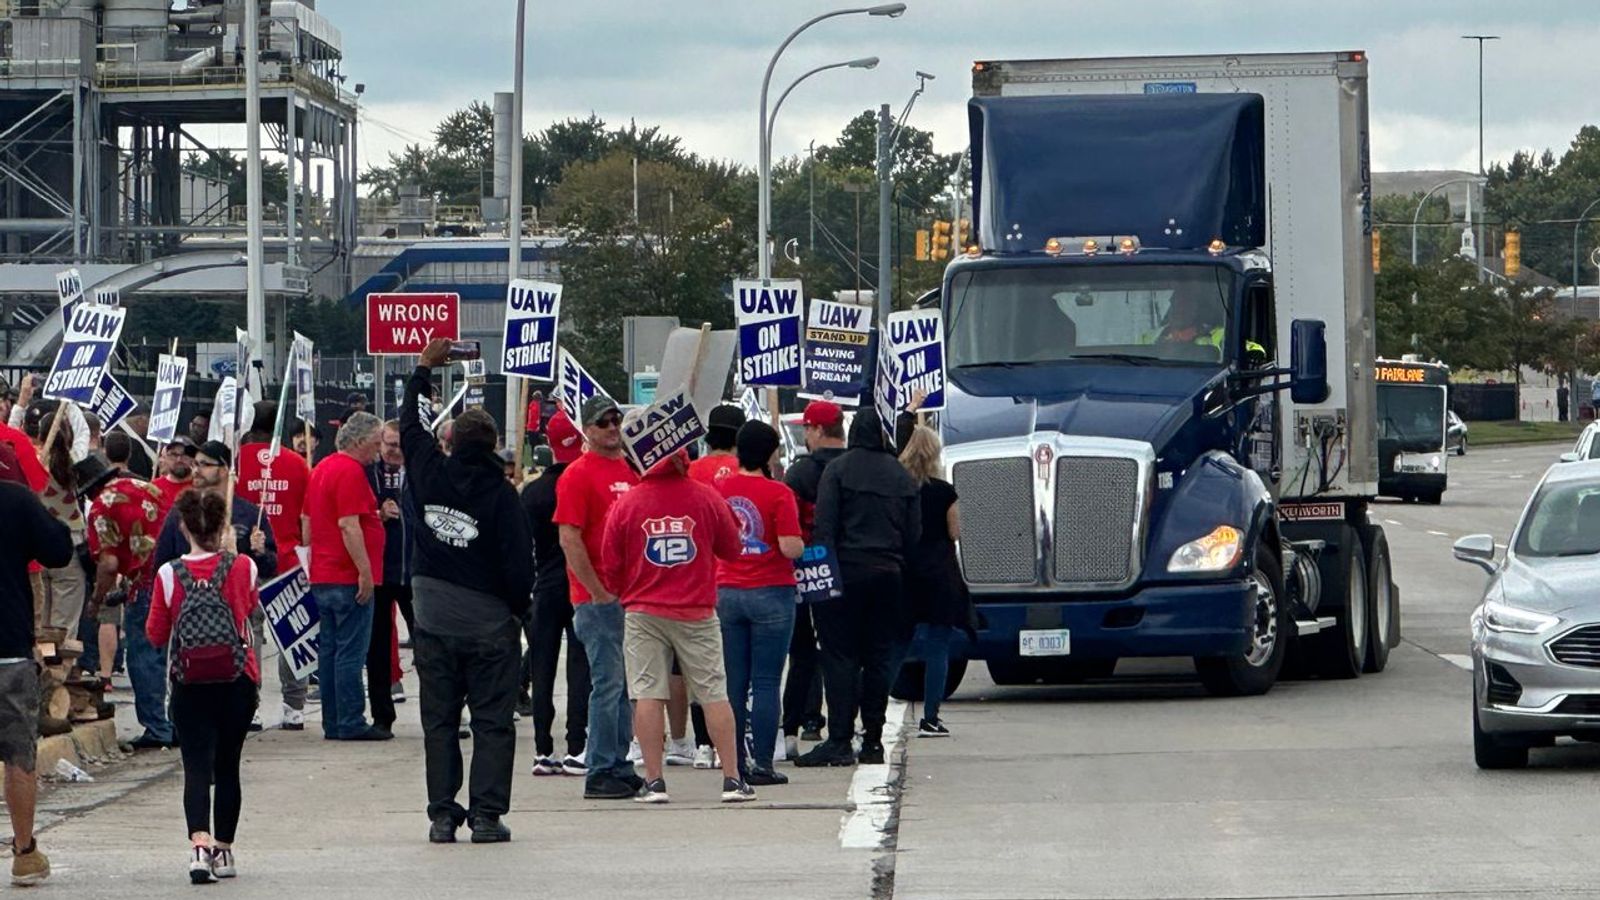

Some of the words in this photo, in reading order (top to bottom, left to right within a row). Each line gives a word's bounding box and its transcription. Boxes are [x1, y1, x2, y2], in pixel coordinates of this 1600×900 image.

[378, 304, 449, 322] WRONG
[511, 287, 557, 315] UAW
[741, 288, 797, 314] UAW
[73, 309, 121, 339] UAW
[820, 303, 862, 329] UAW
[392, 327, 434, 345] WAY
[521, 320, 539, 344] ON
[758, 323, 780, 351] ON
[810, 331, 846, 341] STAND
[892, 317, 938, 344] UAW
[71, 344, 96, 367] ON
[505, 341, 551, 370] STRIKE
[743, 344, 798, 381] STRIKE
[805, 359, 862, 373] AMERICAN
[814, 347, 855, 359] SAVING
[907, 350, 926, 378] ON
[47, 366, 101, 392] STRIKE
[160, 361, 185, 385] UAW
[811, 371, 851, 383] DREAM
[1381, 368, 1425, 382] FAIRLANE
[565, 356, 579, 421] UAW
[623, 393, 684, 438] UAW
[642, 416, 700, 466] STRIKE
[653, 419, 677, 442] ON
[653, 538, 688, 562] 12
[266, 571, 311, 626] STRIKE
[287, 604, 310, 635] ON
